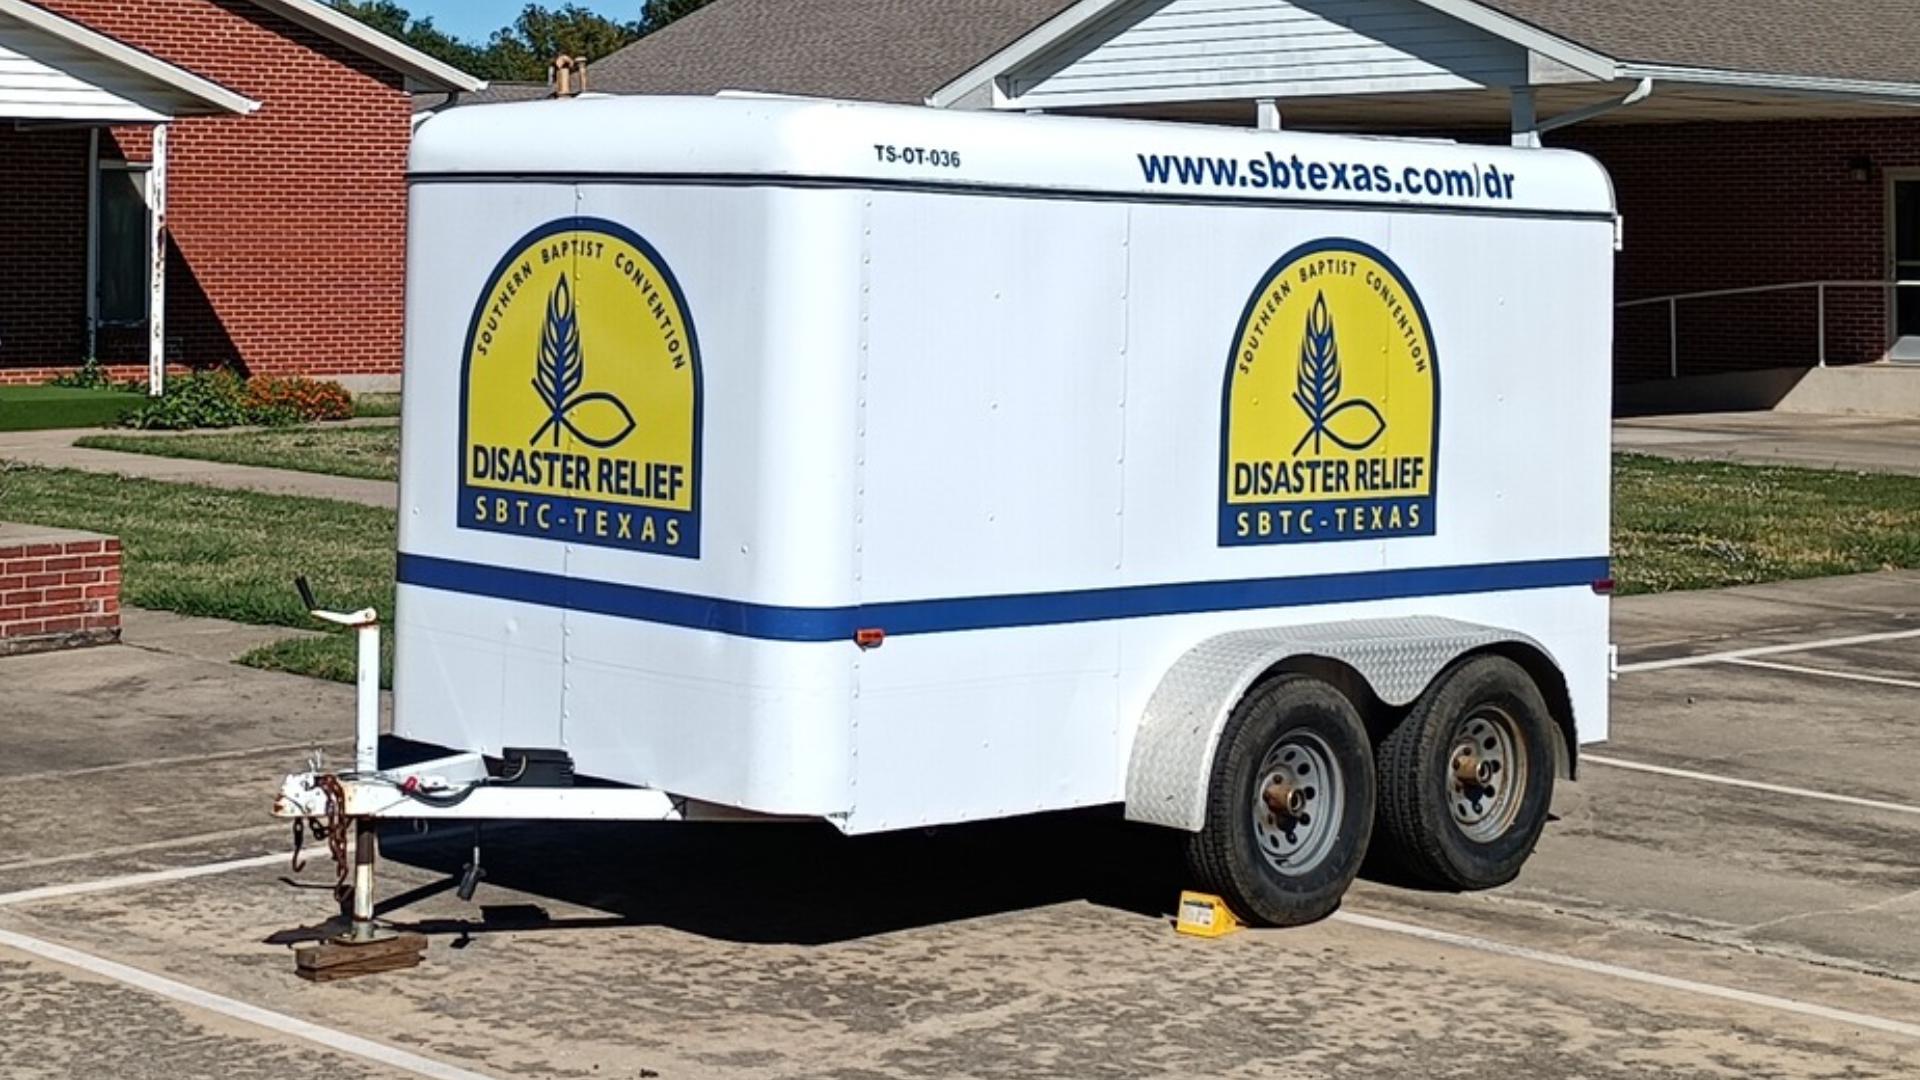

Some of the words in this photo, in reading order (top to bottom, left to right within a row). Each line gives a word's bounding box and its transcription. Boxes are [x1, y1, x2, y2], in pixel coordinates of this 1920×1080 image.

[874, 144, 961, 168] TS-OT-036
[477, 261, 533, 356] SOUTHERN
[541, 240, 604, 265] BAPTIST
[614, 252, 686, 370] CONVENTION
[1239, 280, 1291, 375] SOUTHERN
[1299, 259, 1357, 283] BAPTIST
[1366, 271, 1427, 373] CONVENTION
[472, 444, 591, 491] DISASTER
[597, 457, 684, 501] RELIEF
[1234, 459, 1350, 496] DISASTER
[1354, 457, 1424, 490] RELIEF
